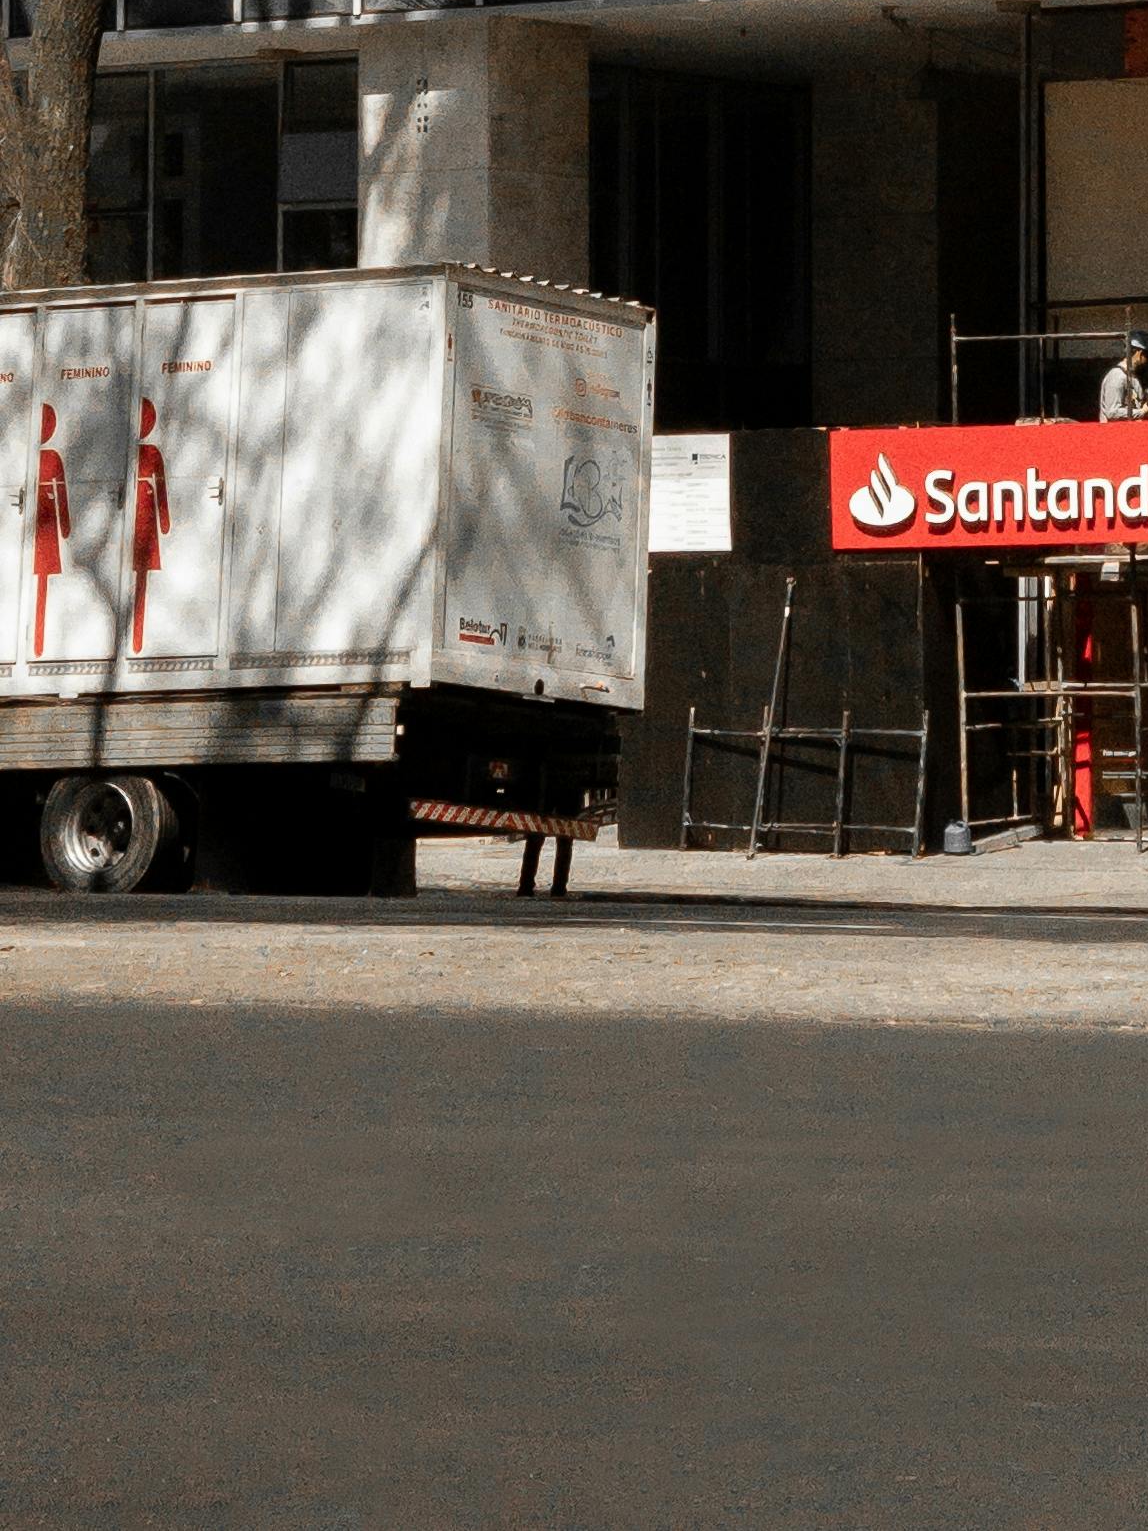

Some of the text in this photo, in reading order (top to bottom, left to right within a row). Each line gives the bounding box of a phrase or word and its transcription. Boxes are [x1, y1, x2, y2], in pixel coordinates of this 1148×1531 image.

[457, 292, 473, 309] 155
[61, 366, 110, 380] FEMININO
[161, 359, 212, 374] FEMININO
